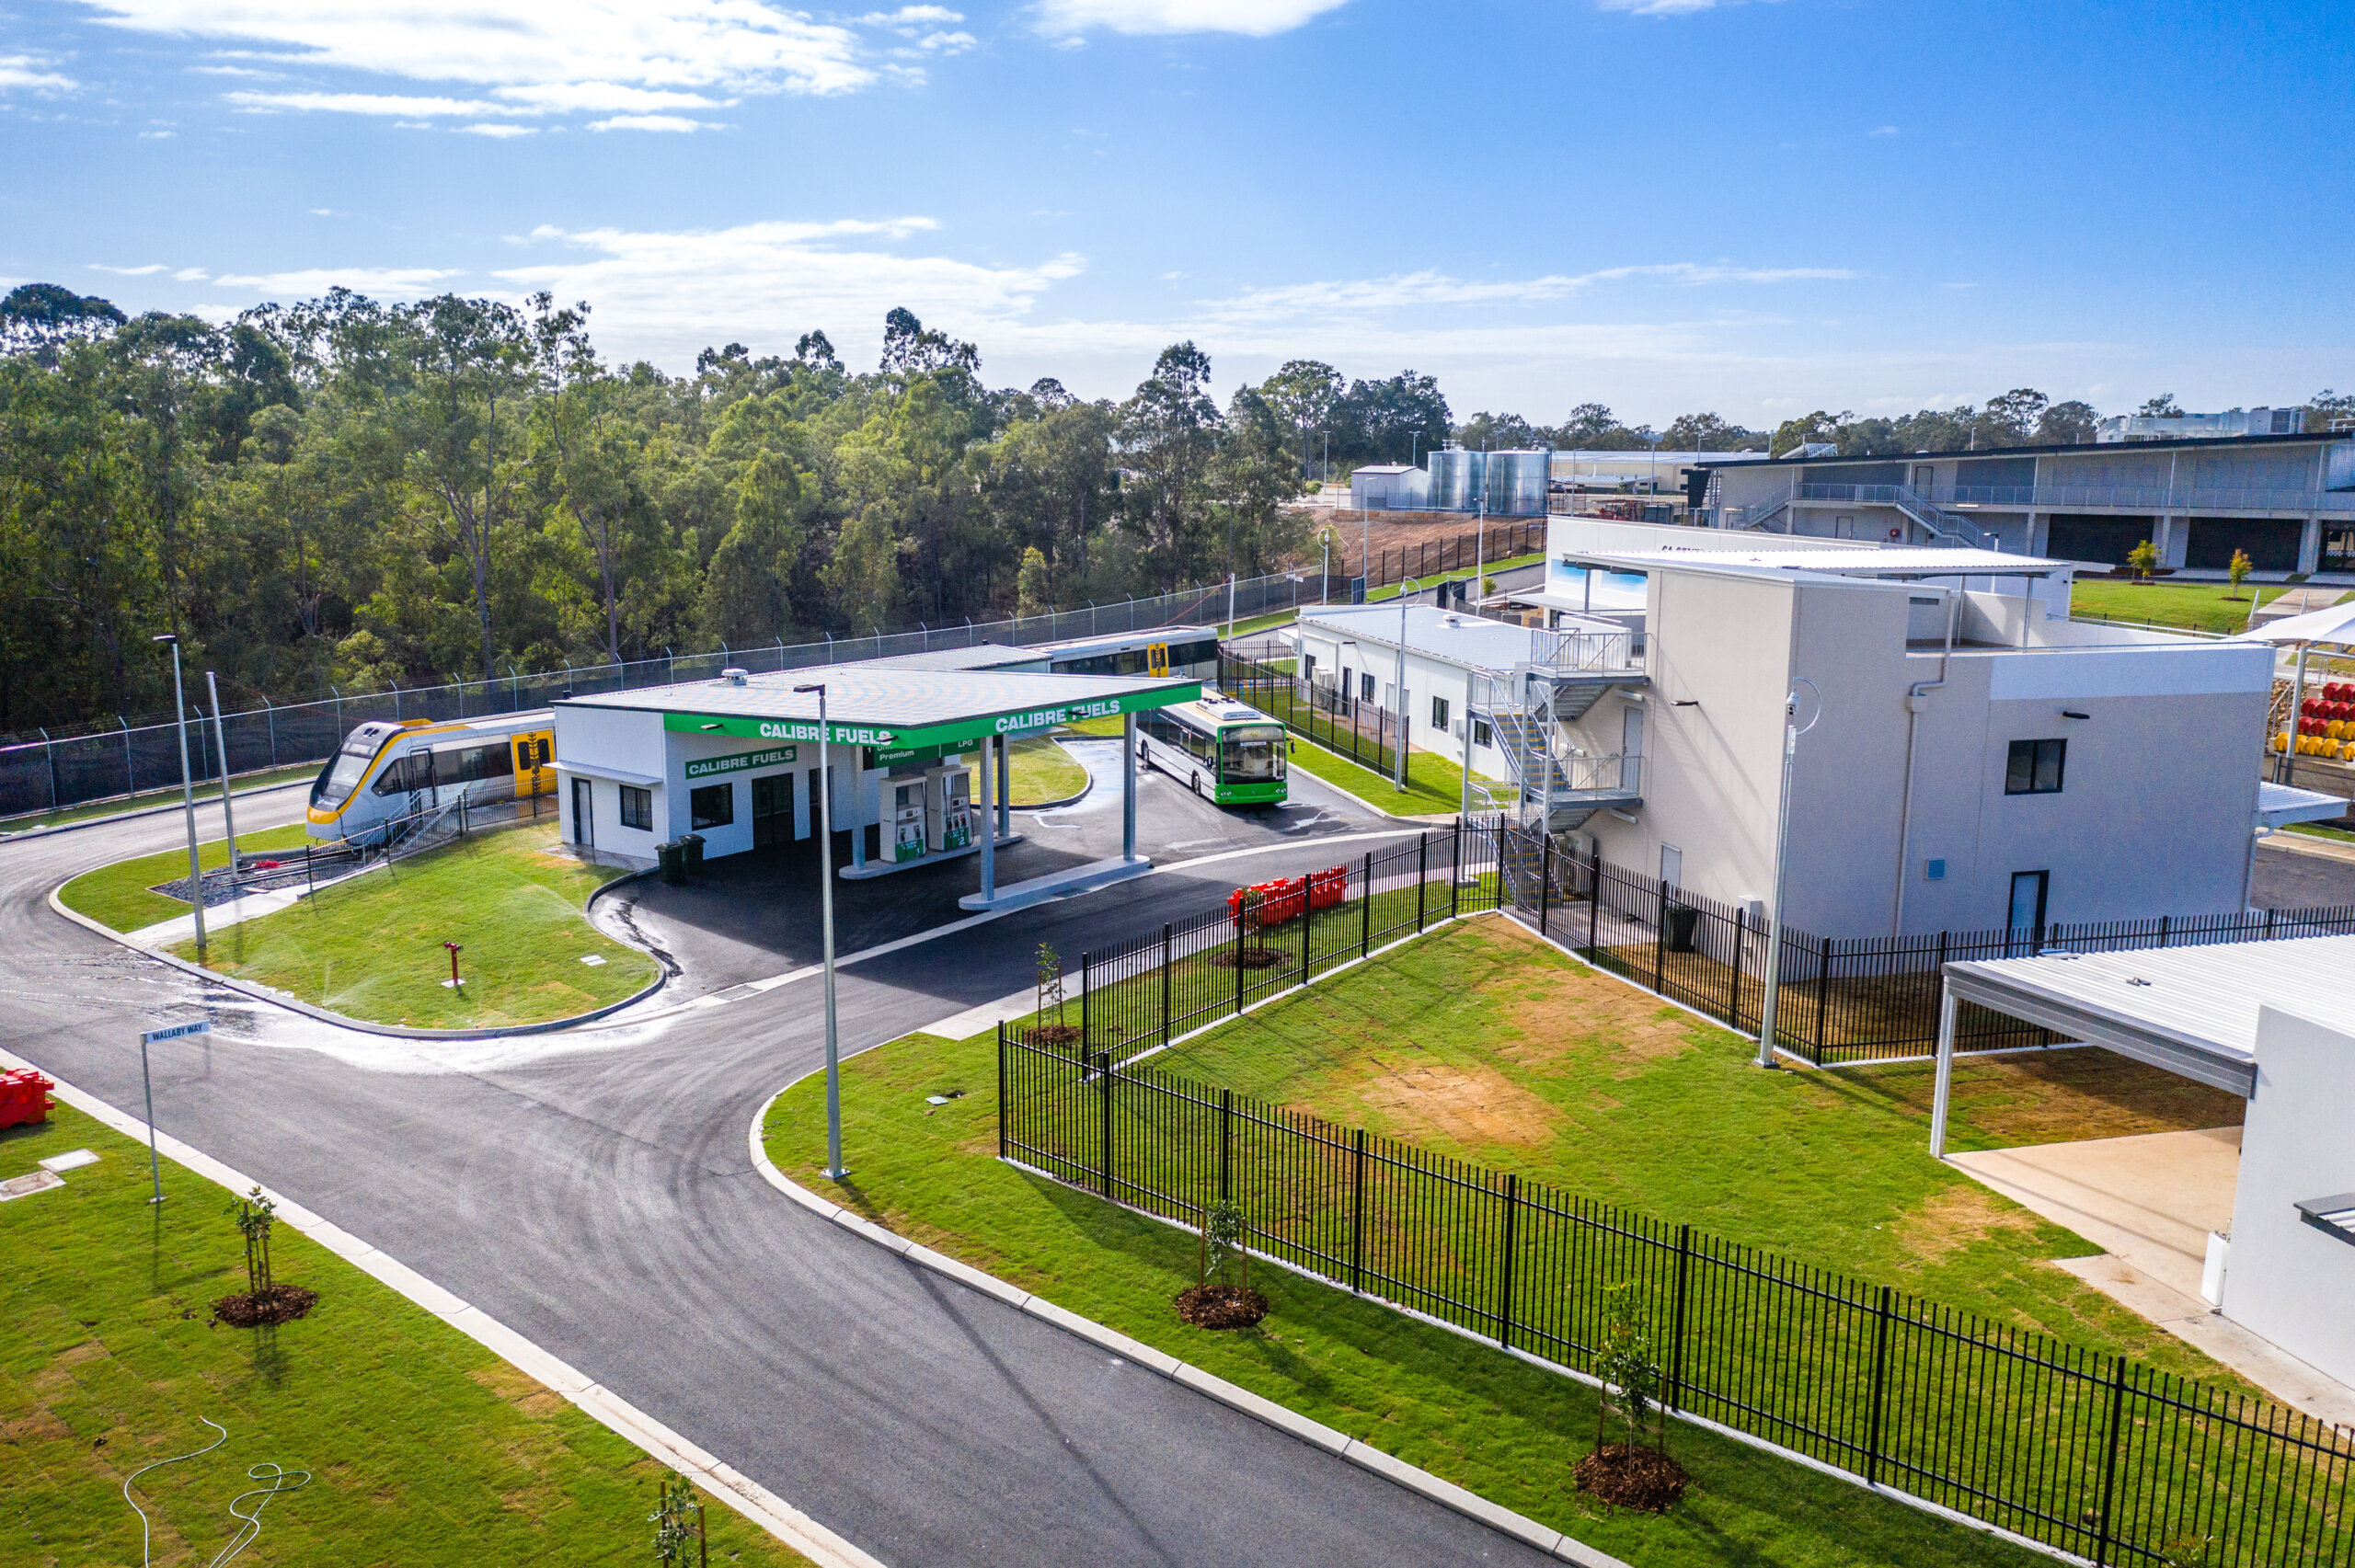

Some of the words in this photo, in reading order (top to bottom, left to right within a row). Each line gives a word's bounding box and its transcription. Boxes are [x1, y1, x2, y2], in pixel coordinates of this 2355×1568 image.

[995, 708, 1067, 733] CALIBRE
[1072, 700, 1120, 720] FUELS
[835, 727, 892, 746] FUELS
[958, 739, 973, 748] LPG
[688, 757, 749, 775] CALIBRE
[752, 750, 794, 764] FUELS
[879, 750, 914, 761] Premium
[152, 1026, 186, 1041] WALLABY
[187, 1024, 202, 1034] WAY
